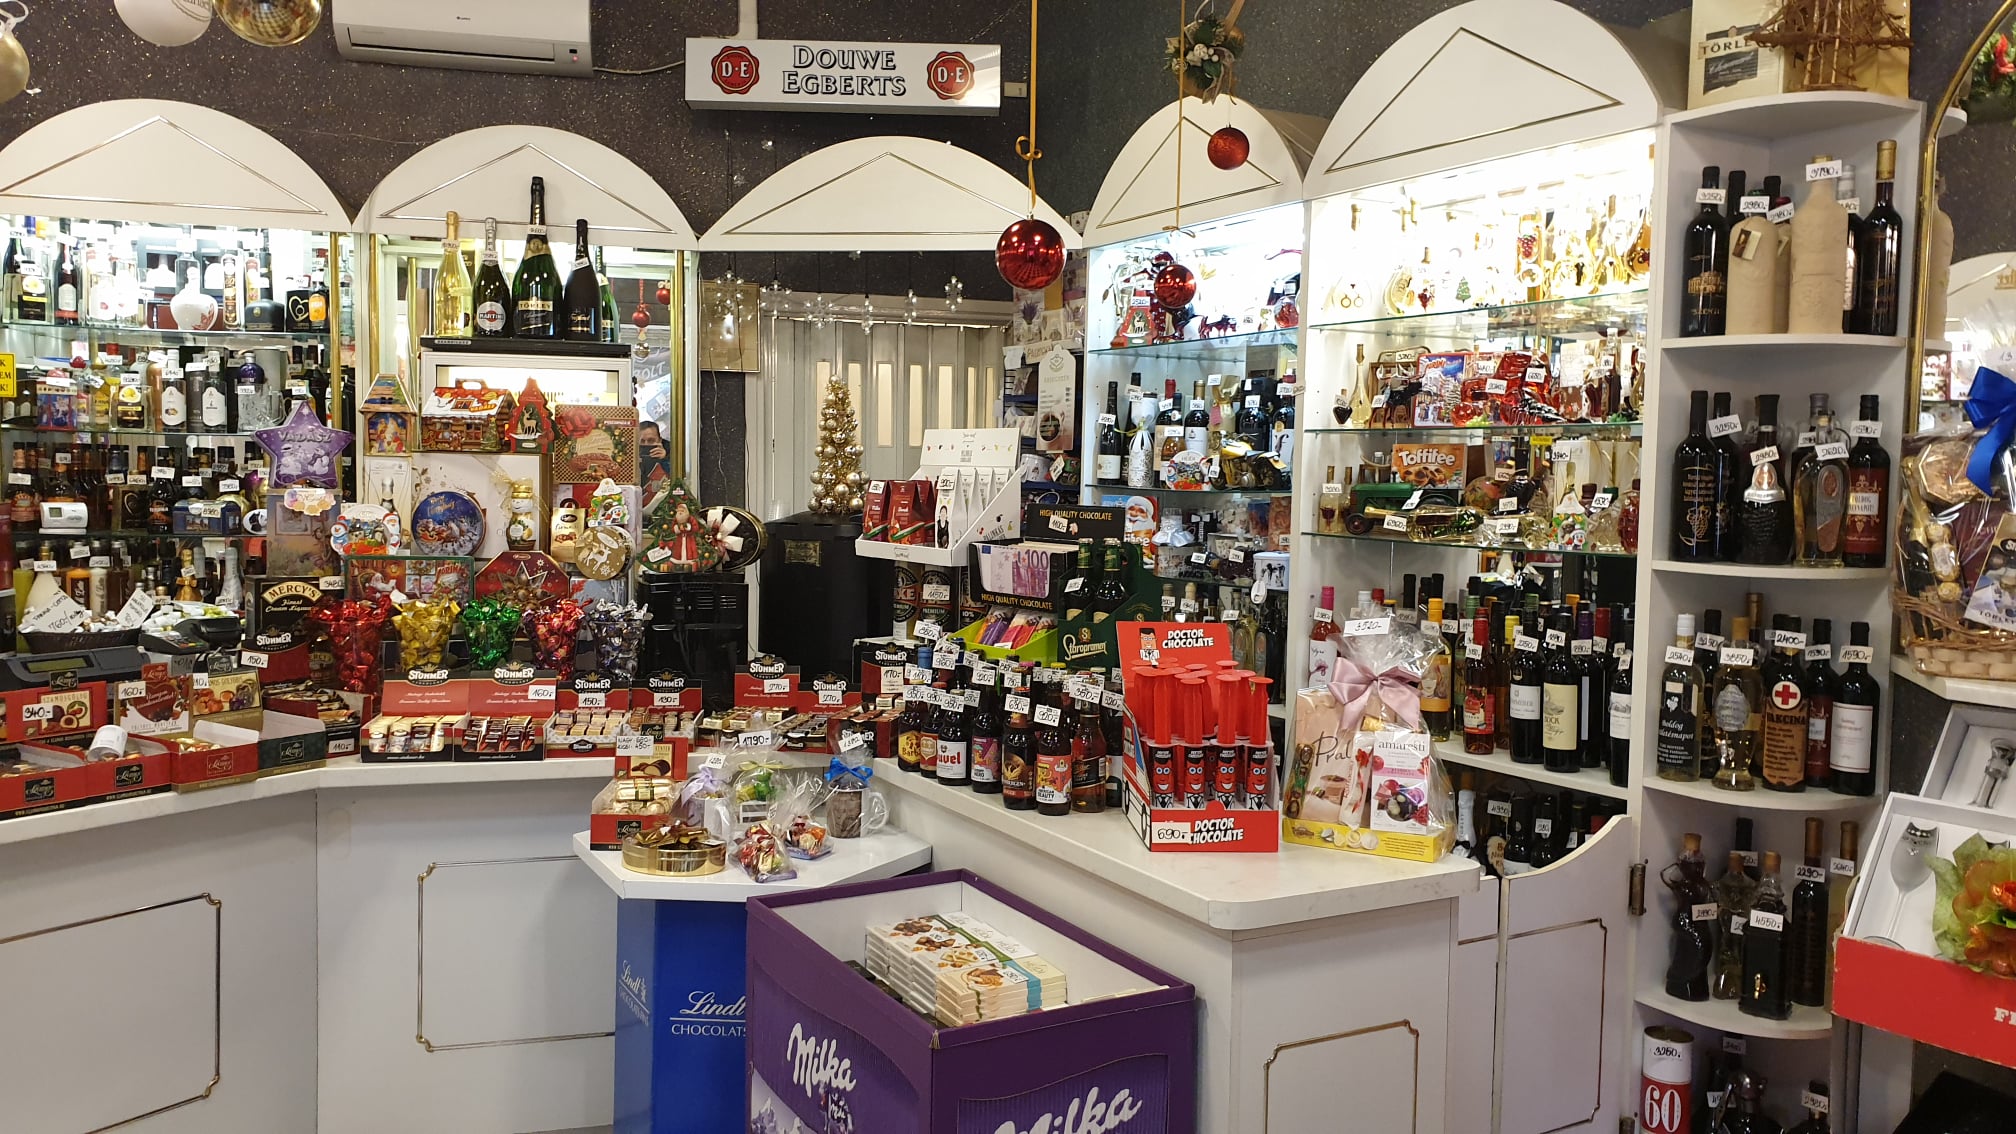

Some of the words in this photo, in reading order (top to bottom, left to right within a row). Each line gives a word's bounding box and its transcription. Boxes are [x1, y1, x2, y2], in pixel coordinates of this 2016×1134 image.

[792, 45, 897, 70] DOUWE
[782, 70, 907, 97] EGBERTS
[1398, 448, 1456, 467] Toffifee
[1055, 511, 1079, 519] QUALITY
[1079, 511, 1113, 521] CHOCOLATE
[1026, 549, 1049, 570] 100
[267, 581, 318, 600] MERCY'S
[981, 593, 996, 602] HIGH
[996, 595, 1019, 606] QUALITY
[1020, 598, 1053, 611] CHOCOLATE
[1162, 637, 1215, 649] CHOCOLATE
[1167, 628, 1204, 639] DOCTOR
[937, 754, 961, 765] uvel
[1193, 817, 1235, 832] DOCTOR
[787, 1022, 857, 1098] Milka
[1644, 1084, 1682, 1133] 60
